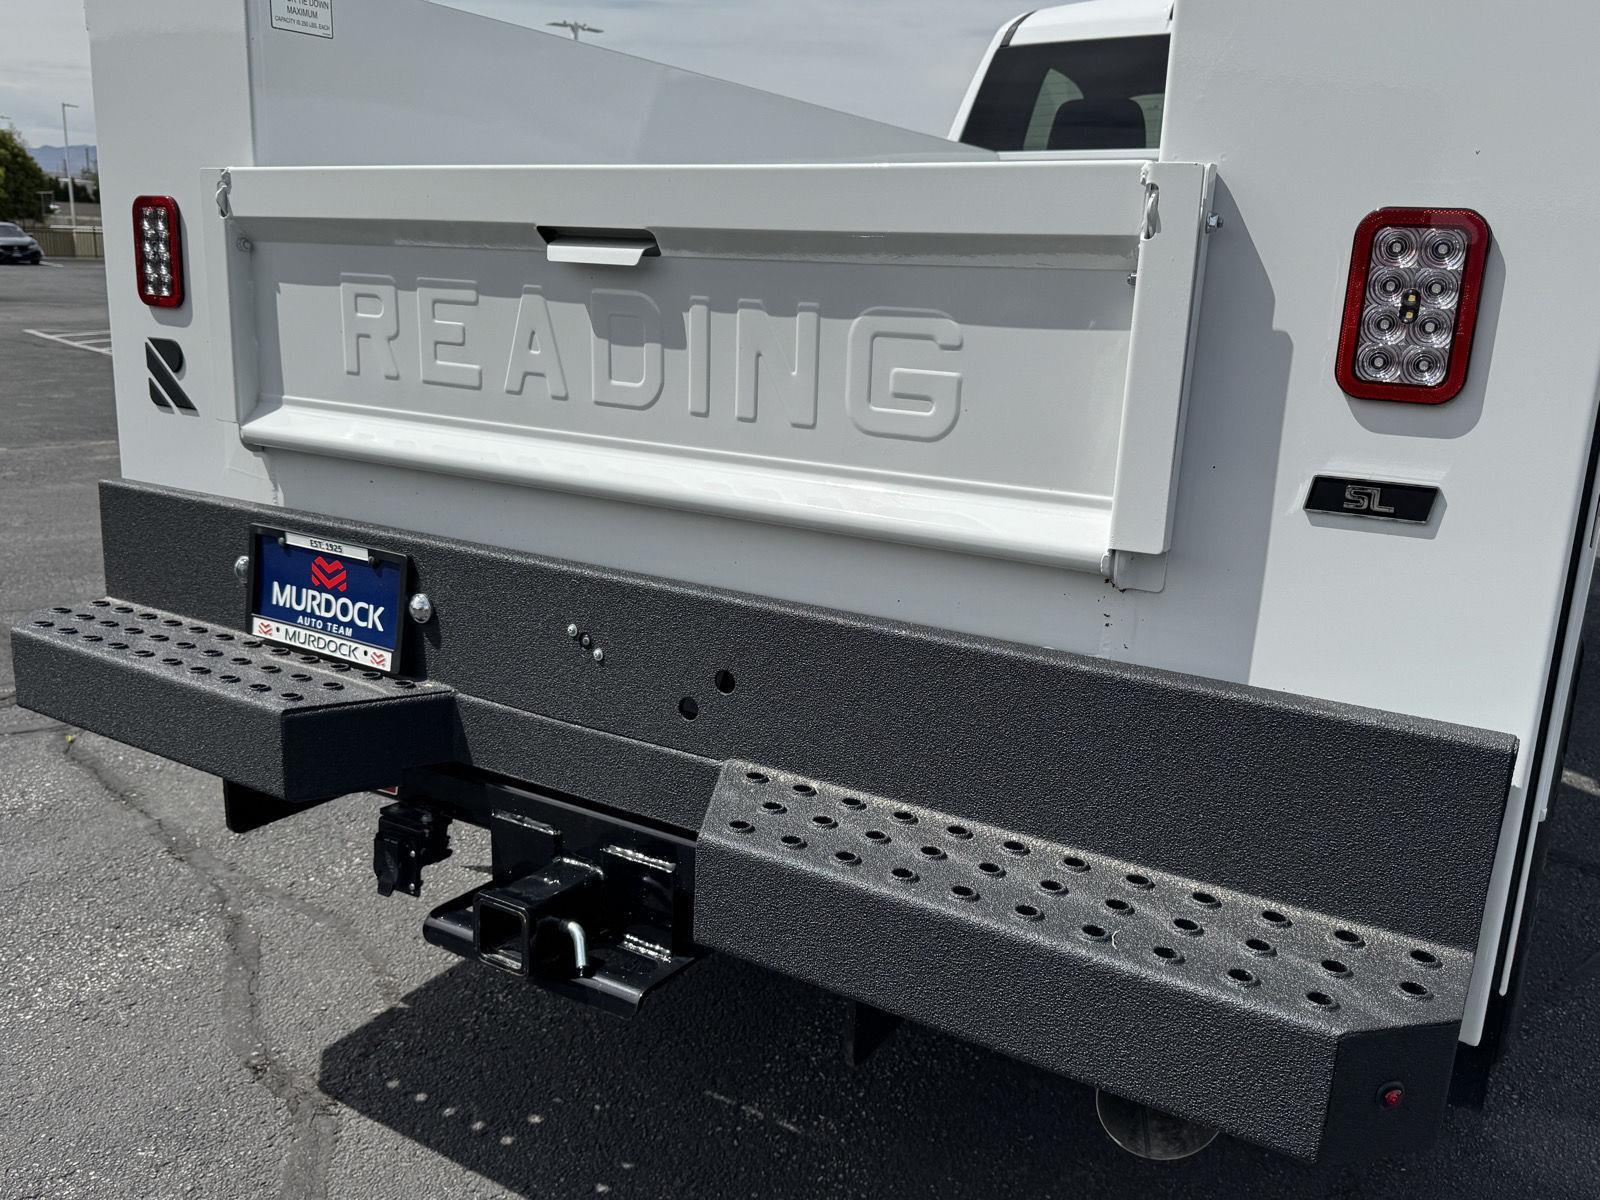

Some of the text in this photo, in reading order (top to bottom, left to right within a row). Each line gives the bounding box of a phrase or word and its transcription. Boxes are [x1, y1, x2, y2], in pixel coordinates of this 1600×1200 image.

[286, 5, 318, 19] MAXIMUM
[309, 0, 329, 10] DOWN
[274, 15, 296, 25] CAPACITY
[339, 272, 964, 443] READING
[1343, 485, 1395, 513] SL
[309, 539, 343, 553] EST. 1925
[271, 580, 385, 632] MURDOCK
[297, 615, 353, 637] AUTO TEAM
[284, 627, 360, 661] MURDOCK
